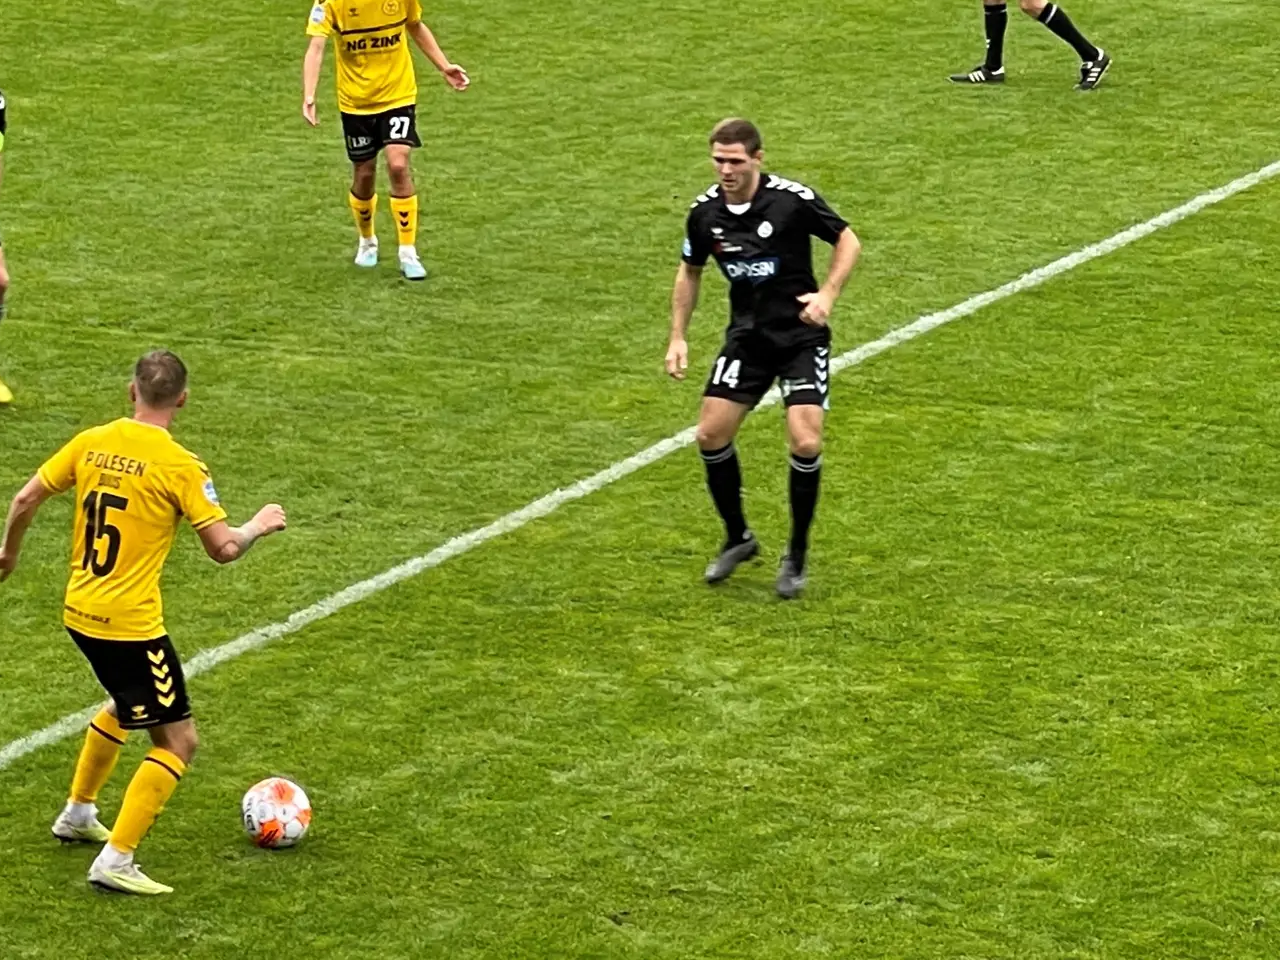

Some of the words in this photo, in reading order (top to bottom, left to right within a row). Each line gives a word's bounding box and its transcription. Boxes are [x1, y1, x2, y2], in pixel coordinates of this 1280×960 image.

[346, 39, 367, 52] NG
[370, 32, 403, 49] ZINK
[389, 116, 410, 139] 27
[712, 356, 742, 388] 14
[82, 490, 129, 577] 15
